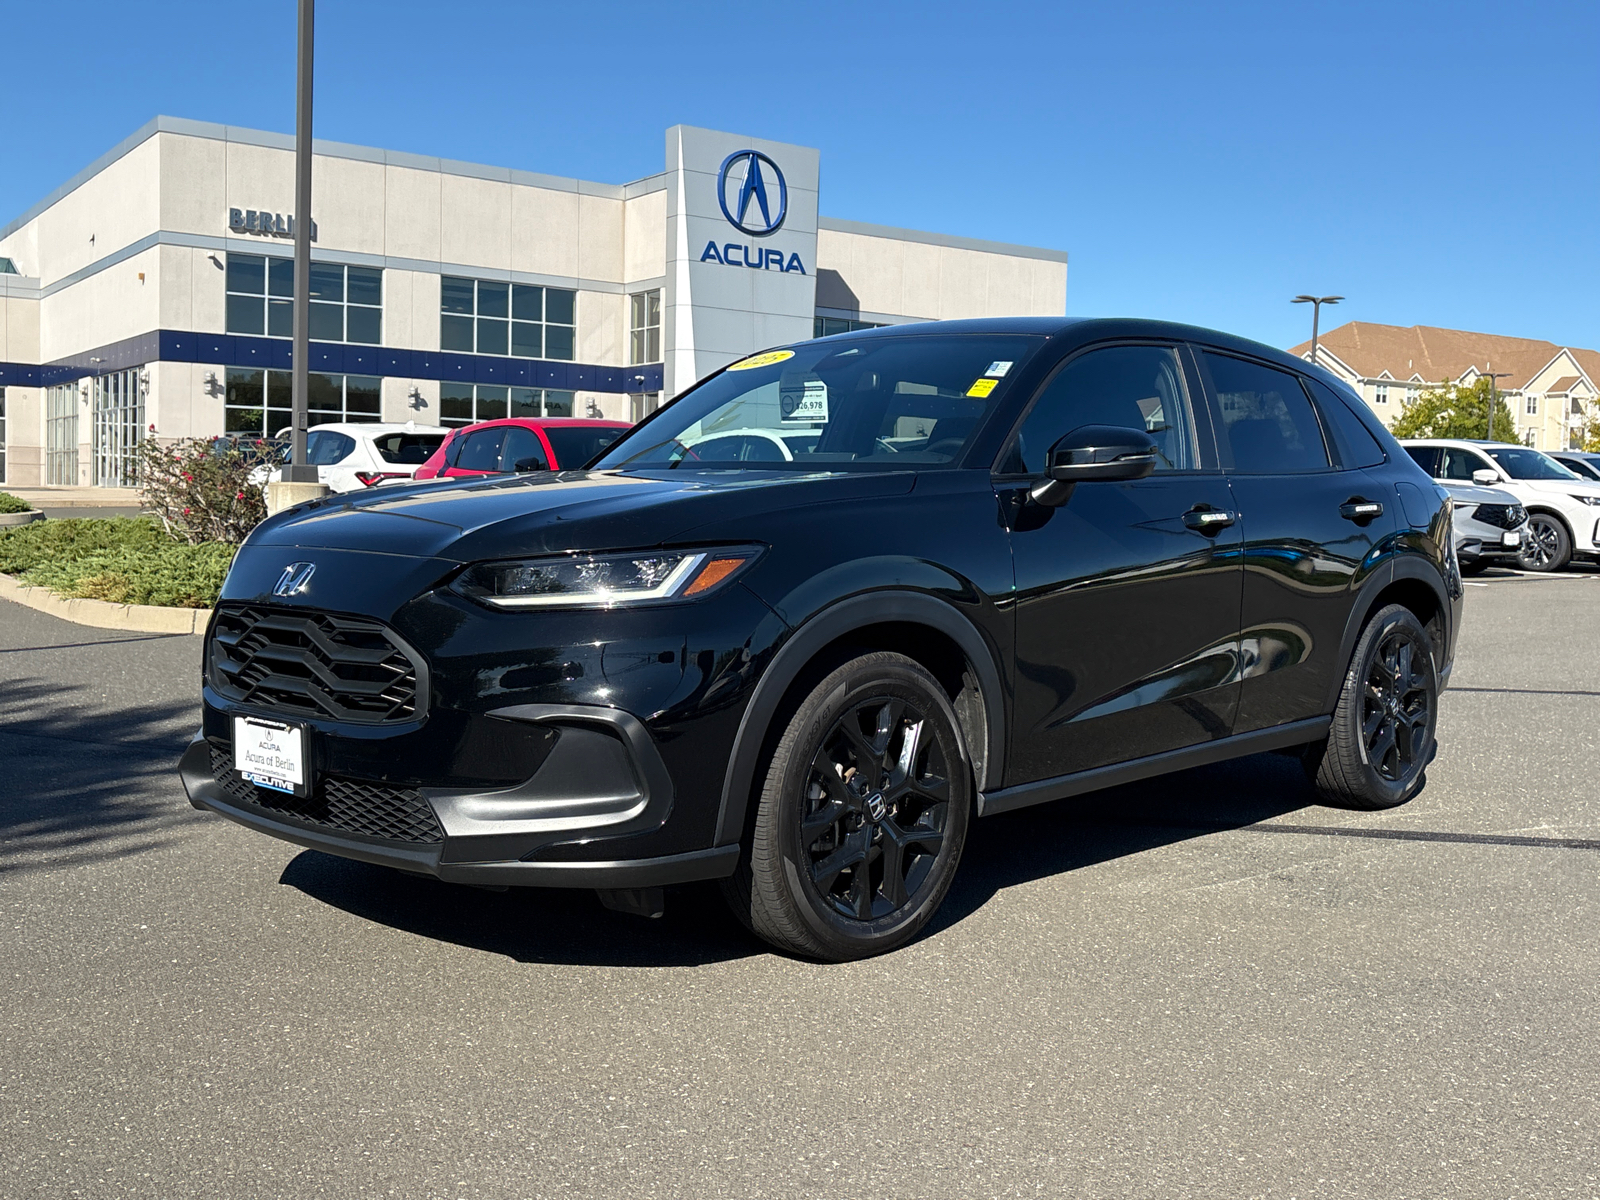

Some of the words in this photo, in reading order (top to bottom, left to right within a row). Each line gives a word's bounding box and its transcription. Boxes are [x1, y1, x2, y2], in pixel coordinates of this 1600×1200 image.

[700, 240, 806, 275] ACURA
[796, 401, 823, 411] $26,978
[258, 741, 281, 753] ACURA
[244, 749, 265, 765] Acura
[265, 755, 274, 767] of
[274, 756, 295, 772] Berlin
[241, 771, 294, 791] EXECUTIVE
